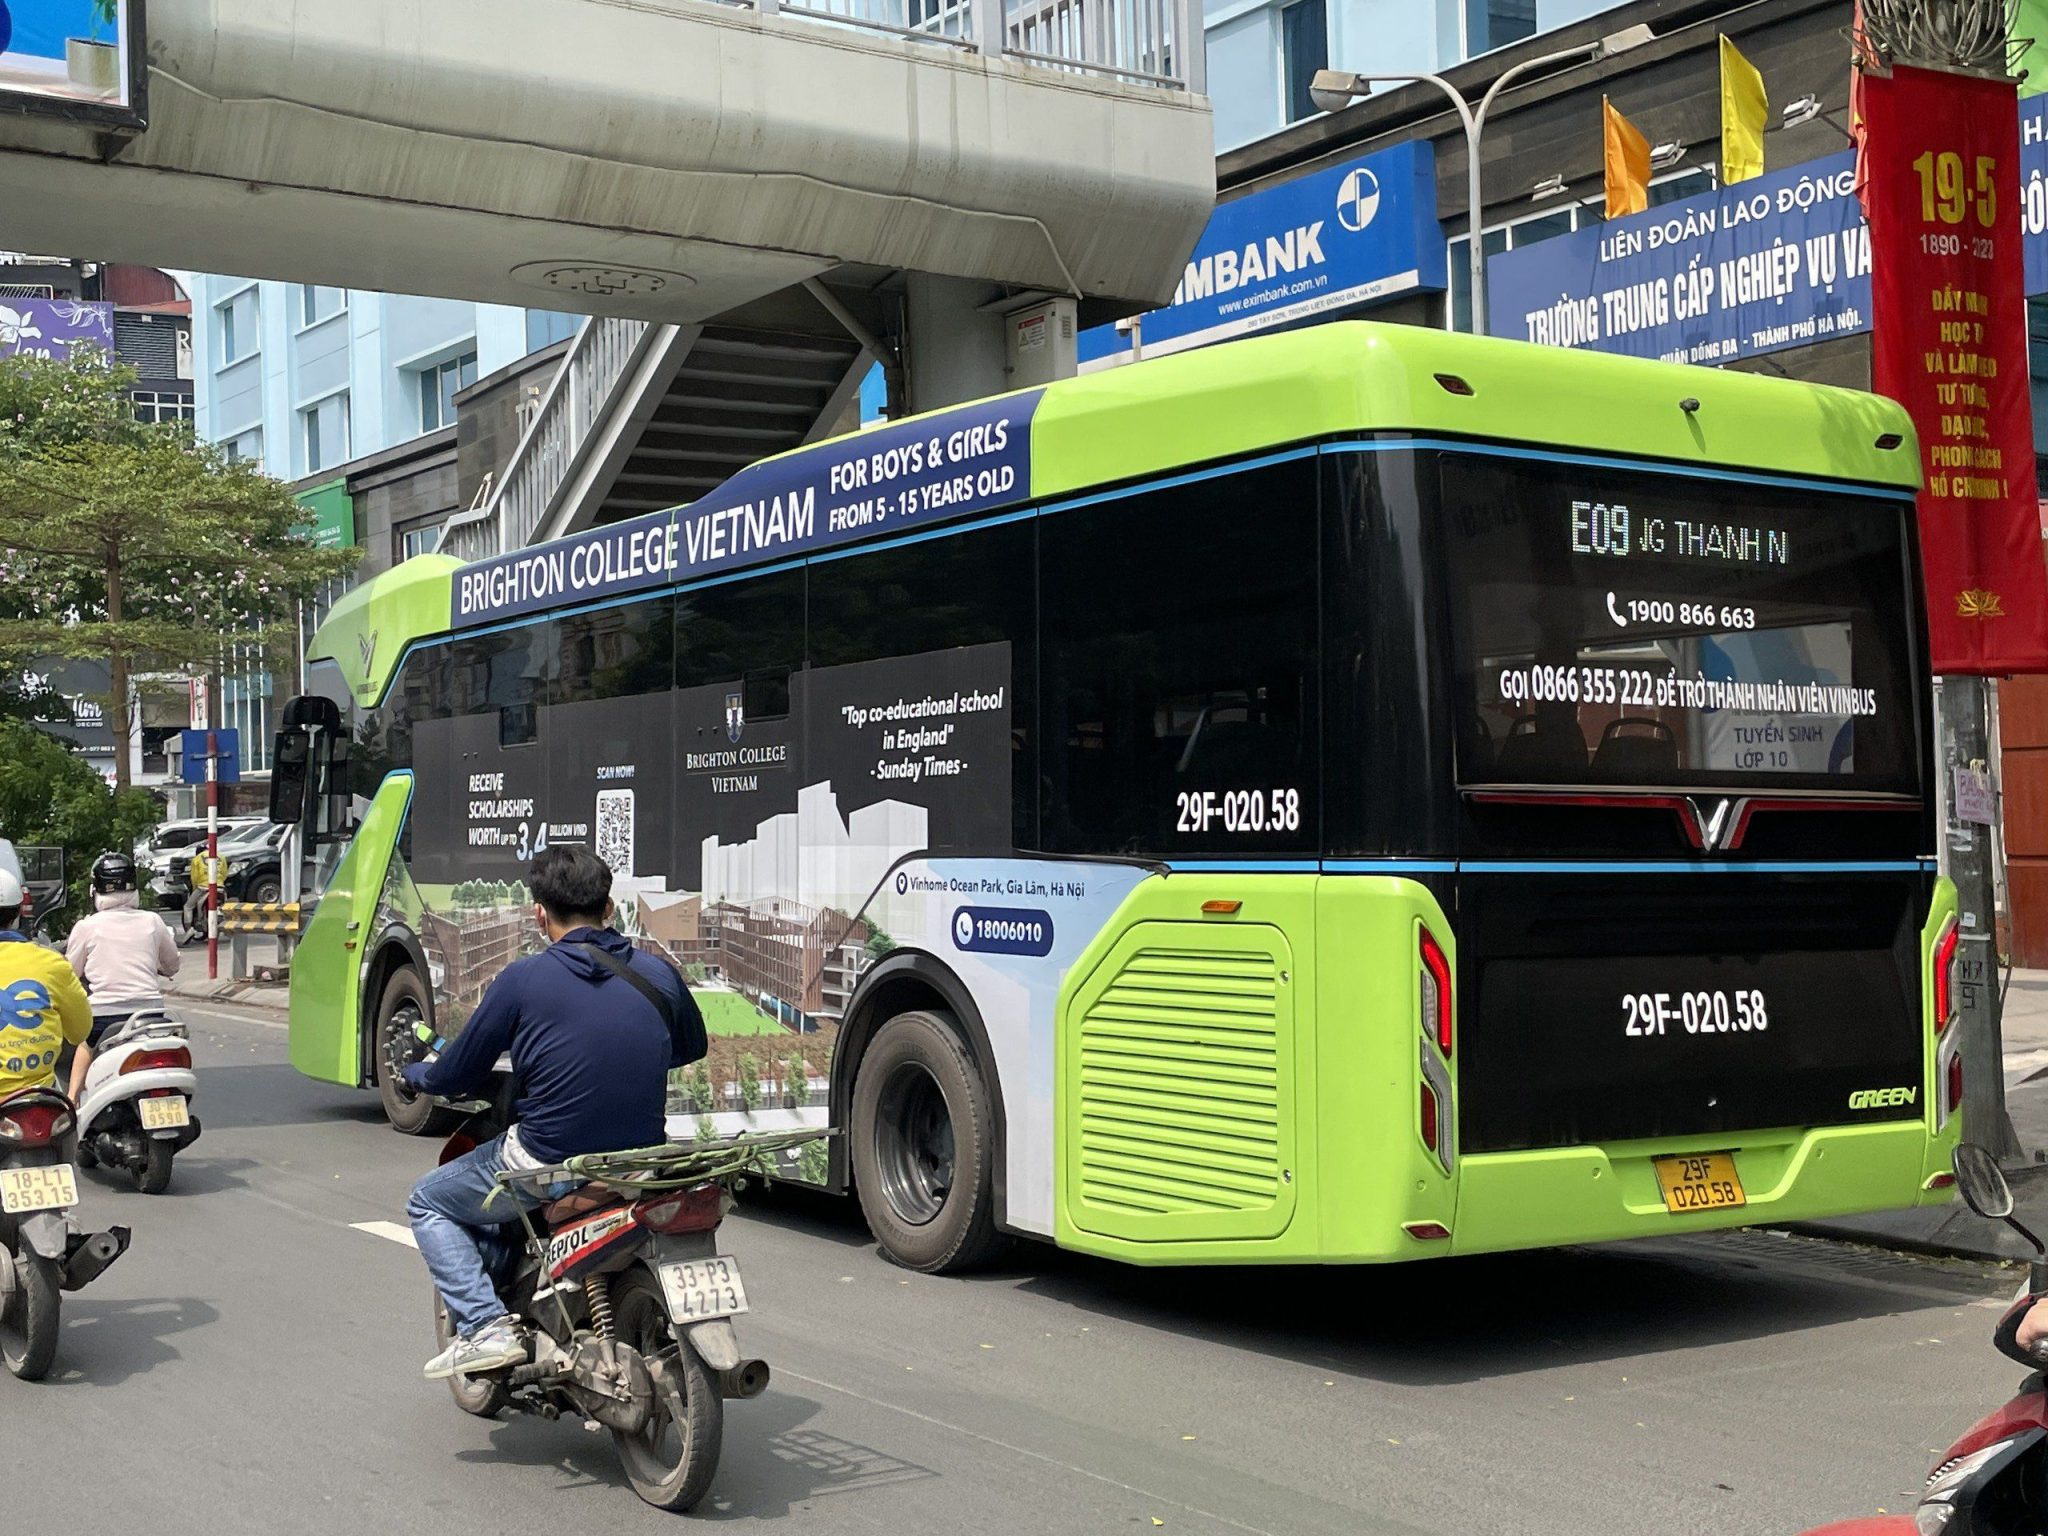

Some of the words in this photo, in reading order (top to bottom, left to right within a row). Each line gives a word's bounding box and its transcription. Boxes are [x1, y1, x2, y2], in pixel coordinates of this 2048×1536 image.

[1600, 229, 1642, 262] LIÊN
[1647, 208, 1716, 249] ĐOÀN
[1723, 195, 1770, 228] LAO
[1776, 171, 1856, 214] ĐỘNG
[2023, 115, 2048, 145] H
[1920, 234, 1960, 255] 1890
[1168, 220, 1326, 308] MBANK
[1218, 274, 1328, 316] www.eximbank.com.vn
[1525, 293, 1599, 348] TRƯỜNG
[1603, 277, 1669, 336] TRUNG
[1673, 254, 1714, 320] CẤP
[1719, 237, 1800, 310] NGHIỆP
[1806, 233, 1838, 293] VỤ
[1722, 338, 1738, 355] ĐA
[1752, 321, 1789, 348] THÀNH
[1790, 313, 1817, 341] PHỐ
[1818, 311, 1836, 334] HÀ
[1837, 307, 1863, 331] NỘI.
[1941, 322, 1970, 347] HỌC
[1925, 347, 1944, 373] VÀ
[1949, 348, 1978, 374] LÀM
[1936, 383, 1957, 405] TƯ
[1941, 415, 1971, 440] ĐẠO
[830, 456, 867, 495] FOR
[871, 441, 924, 485] BOYS
[928, 437, 943, 468] &
[947, 418, 1009, 462] GIRLS
[828, 505, 873, 533] FROM
[876, 500, 886, 522] 5
[899, 489, 918, 516] 15
[921, 474, 974, 509] YEARS
[977, 465, 1015, 498] OLD
[1571, 500, 1630, 556] E09
[460, 550, 565, 615] BRIGHTON
[569, 524, 679, 590] COLLEGE
[685, 487, 815, 564] VIETNAM
[1628, 599, 1674, 624] 1900
[1679, 603, 1716, 627] 866
[1720, 605, 1756, 630] 663
[1500, 669, 1528, 707] GỌI
[1531, 664, 1579, 703] 0866
[1582, 667, 1616, 704] 355
[1620, 670, 1654, 706] 222
[1656, 667, 1676, 706] ĐỂ
[1677, 669, 1706, 709] TRỞ
[1708, 673, 1756, 711] THÀNH
[1757, 678, 1797, 713] NHÂN
[1797, 681, 1828, 714] VIÊN
[1828, 687, 1877, 716] VINBUS
[869, 692, 958, 723] co-educational
[959, 686, 1004, 714] school
[883, 730, 895, 750] in
[896, 724, 954, 753] England"
[1788, 726, 1823, 743] SINH
[687, 751, 737, 770] BRIGHTON
[739, 745, 786, 765] COLLEGE
[877, 759, 921, 783] Sunday
[924, 756, 960, 777] Times
[1735, 748, 1763, 769] LỚP
[1769, 751, 1788, 767] 10
[469, 773, 504, 792] RECEIVE
[597, 766, 615, 779] SCAN
[615, 765, 635, 778] NOW!
[711, 775, 758, 794] VIETNAM
[468, 799, 533, 819] SCHOLARSHIPS
[1176, 788, 1300, 832] 29F-020.58
[468, 827, 500, 845] WORTH
[501, 834, 508, 845] UP
[508, 833, 517, 845] TO
[516, 822, 547, 861] 3.4
[549, 824, 572, 836] BILLION
[910, 877, 948, 892] Vinhome
[950, 878, 979, 893] Ocean
[980, 878, 1005, 896] Park,
[1006, 879, 1024, 895] Gia
[1025, 879, 1049, 898] Lâm,
[1050, 881, 1065, 897] Hà
[1066, 881, 1086, 901] Nội
[976, 919, 1042, 943] 18006010
[0, 979, 52, 1031] e
[1622, 989, 1768, 1037] 29F-020.58
[1849, 1086, 1917, 1109] GREEN
[150, 1111, 182, 1127] 9590
[12, 1168, 63, 1189] 18-L1
[1678, 1158, 1712, 1182] 29F
[7, 1186, 74, 1209] 353.15
[1672, 1181, 1737, 1208] 020.58
[673, 1260, 731, 1289] 33-P3
[683, 1286, 739, 1317] 4273
